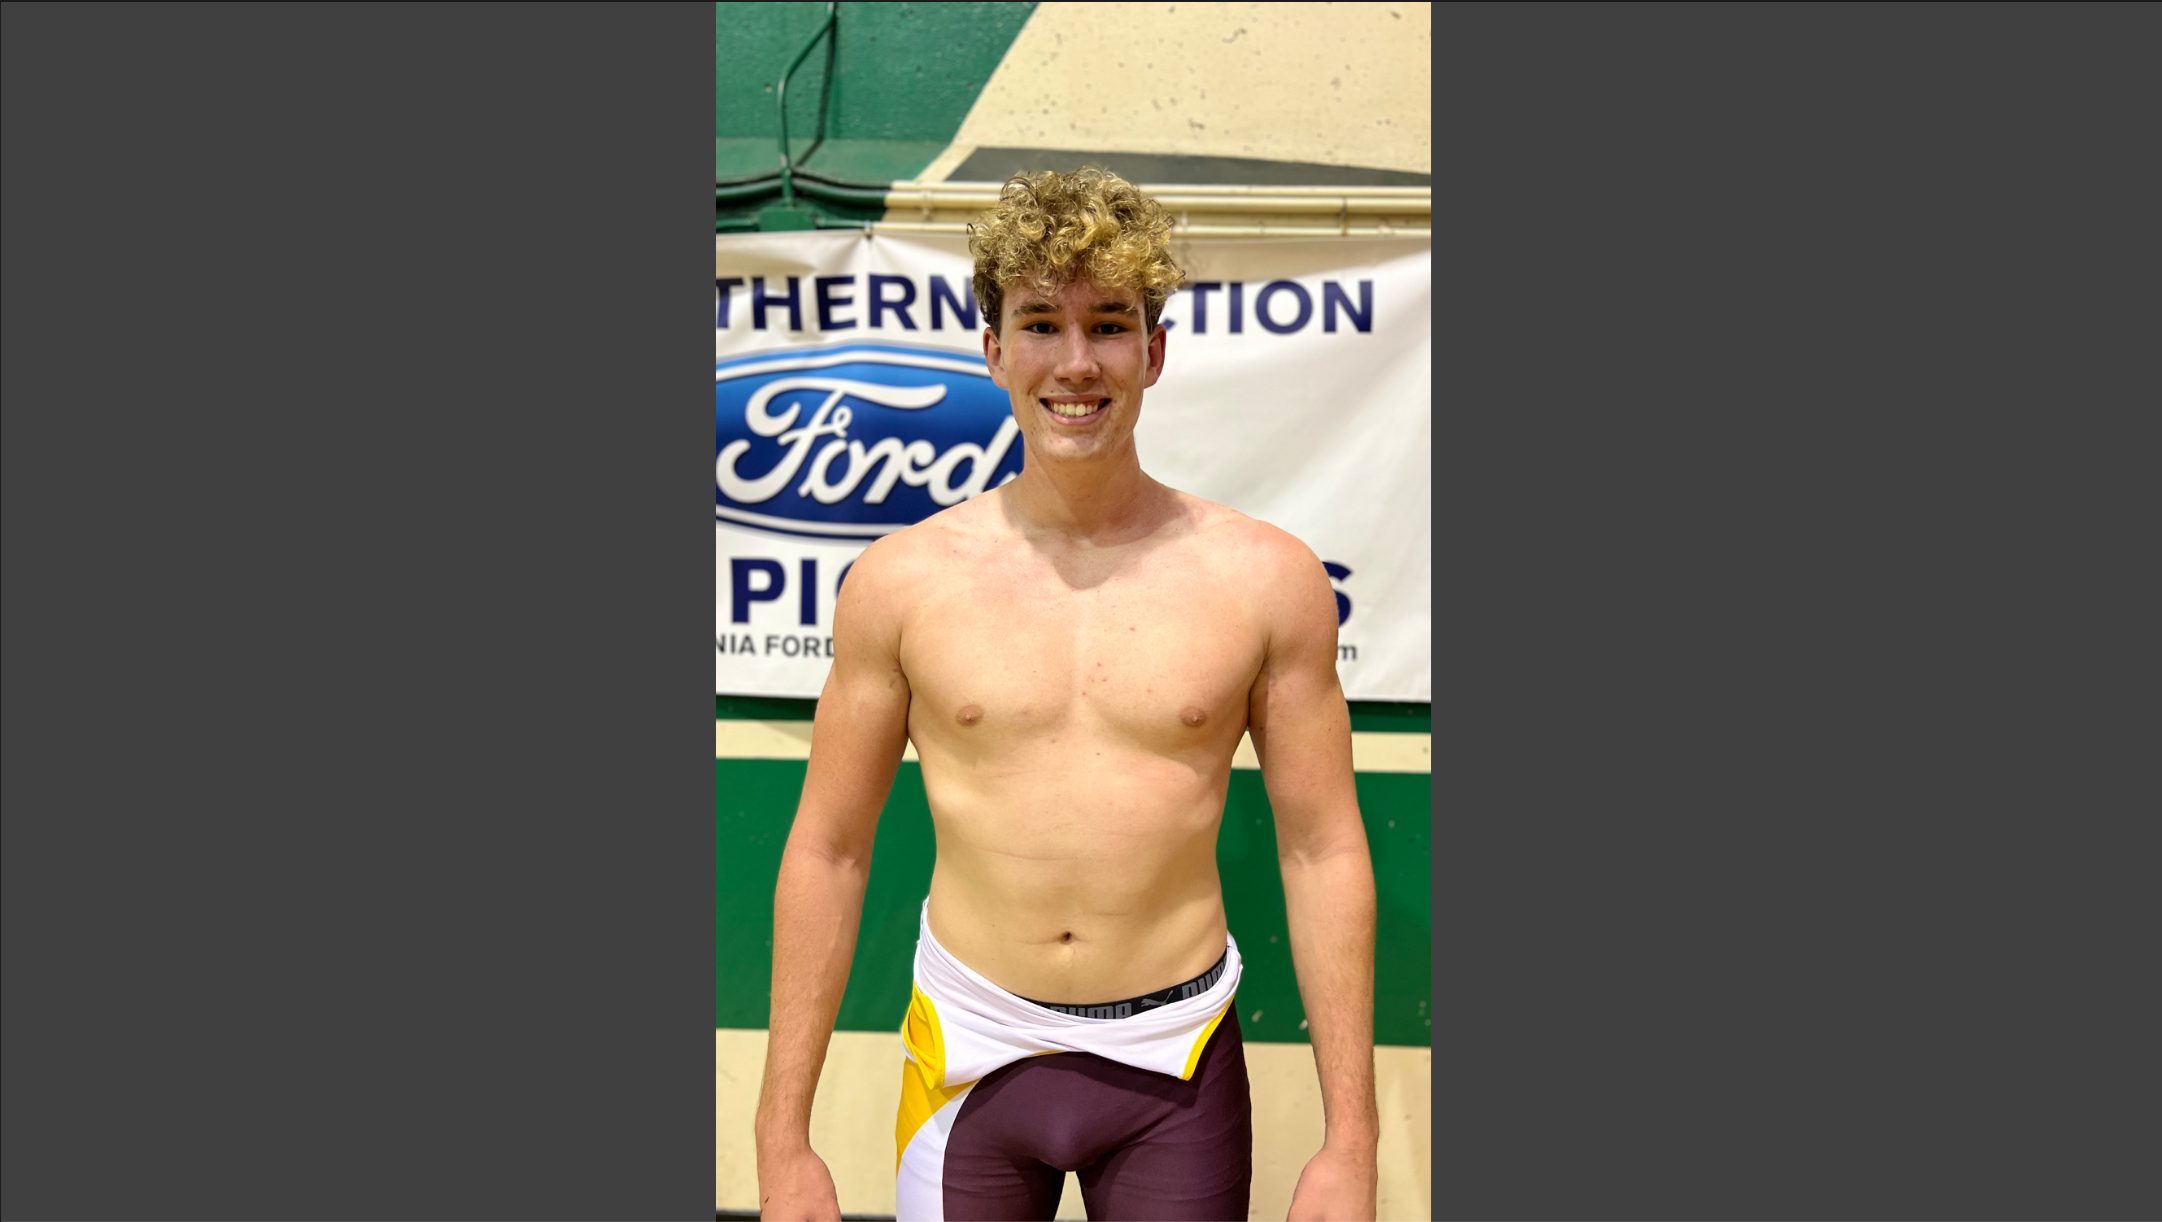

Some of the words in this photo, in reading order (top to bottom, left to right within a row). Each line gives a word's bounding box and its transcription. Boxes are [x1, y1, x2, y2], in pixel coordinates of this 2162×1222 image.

[716, 273, 978, 332] THERN
[1163, 279, 1374, 335] TION
[715, 376, 1021, 506] Ford
[730, 556, 855, 627] PI
